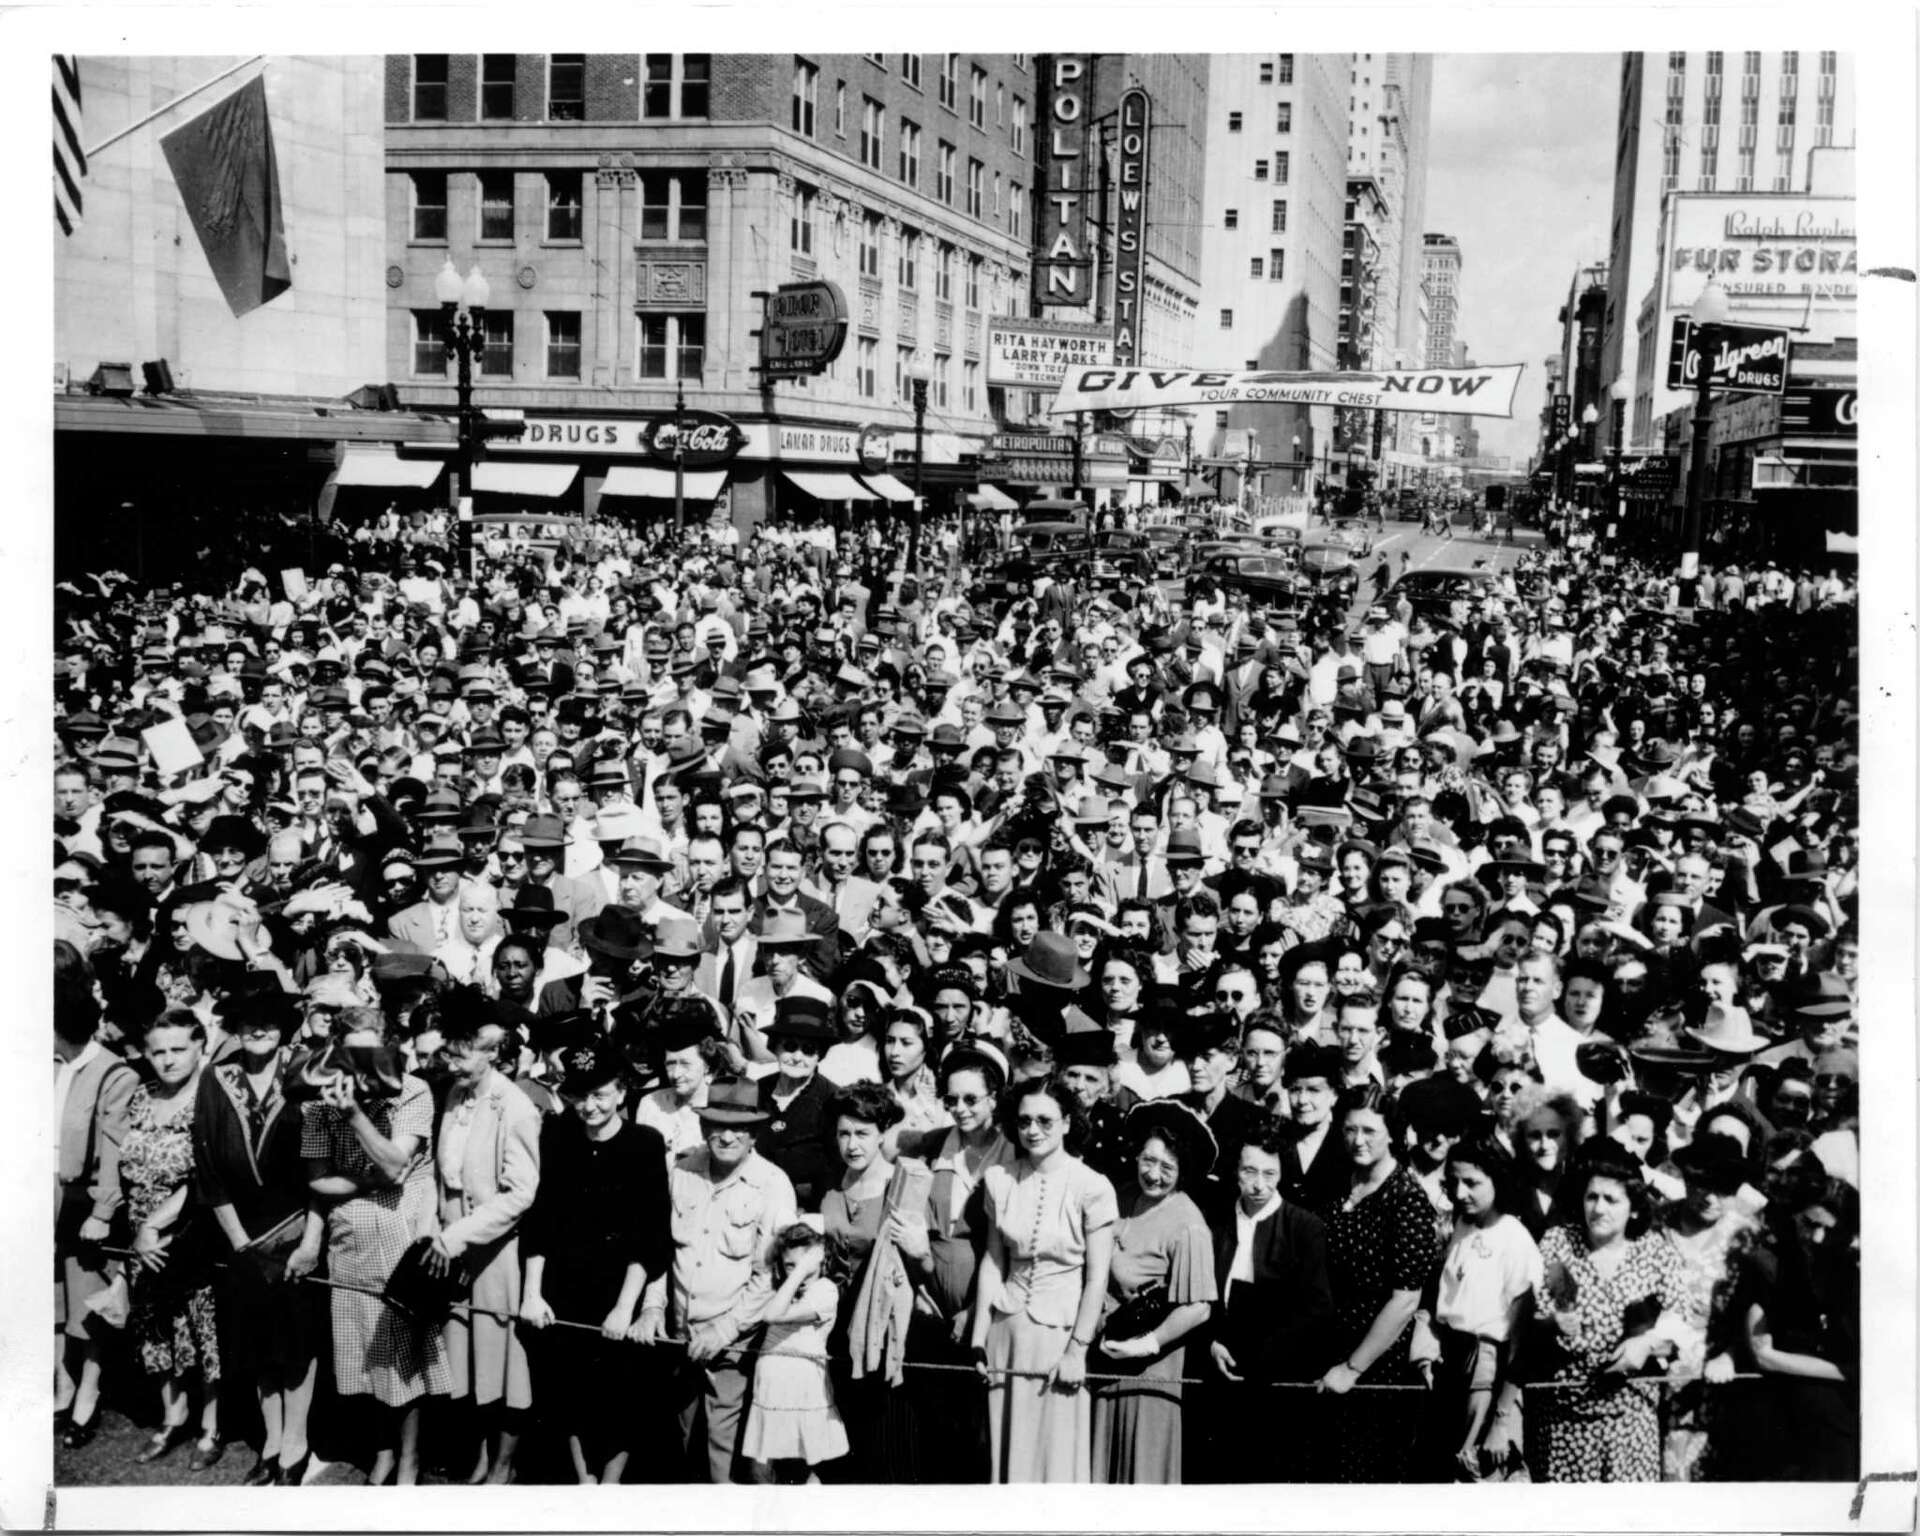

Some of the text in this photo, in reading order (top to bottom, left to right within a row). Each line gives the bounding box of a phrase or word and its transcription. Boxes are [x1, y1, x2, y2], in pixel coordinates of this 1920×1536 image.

[1049, 59, 1083, 294] POLITAN
[1674, 248, 1742, 272] FUR
[1719, 282, 1787, 294] NSURED
[994, 332, 1106, 353] RITA HAYWORTH
[1002, 347, 1098, 365] LARRY PARKS
[1077, 370, 1234, 392] GIVE
[1381, 375, 1493, 397] NOW
[1737, 370, 1780, 387] DRUGS
[1200, 387, 1383, 406] YOUR COMMUNITY CHEST
[530, 424, 618, 443] DRUGS
[820, 434, 850, 454] DRUGS
